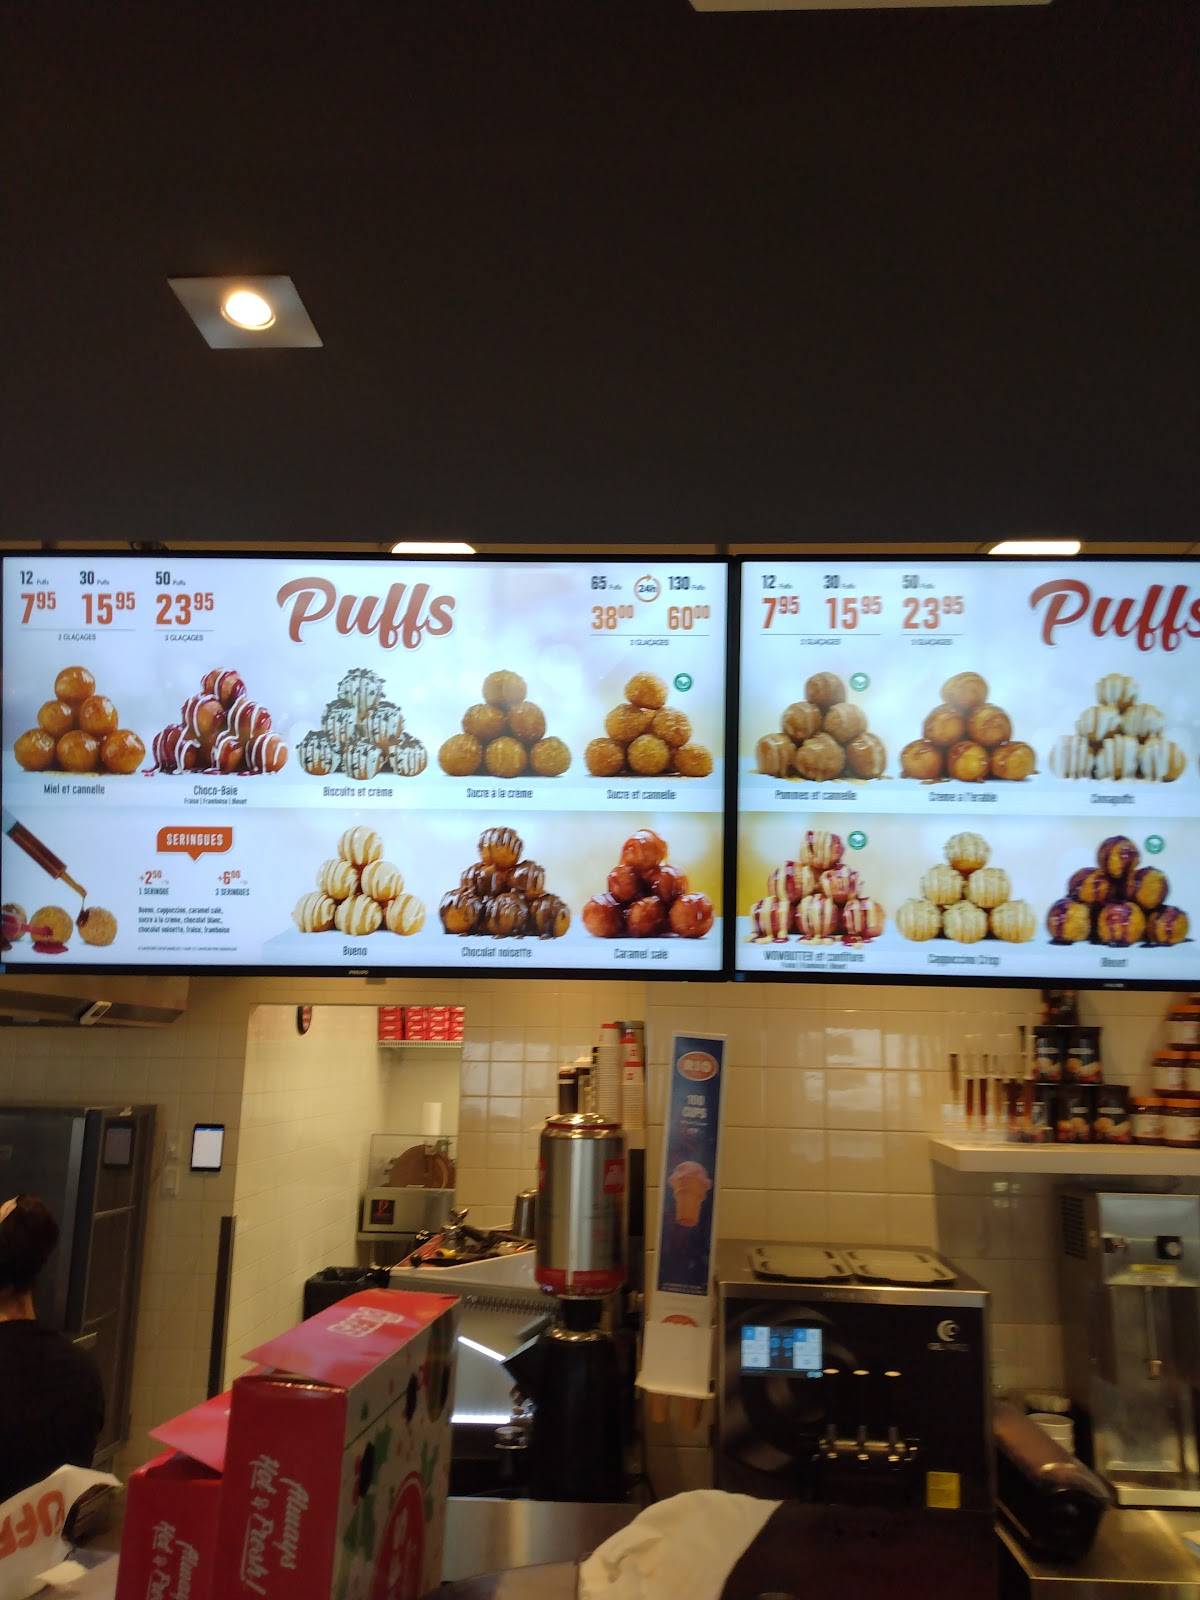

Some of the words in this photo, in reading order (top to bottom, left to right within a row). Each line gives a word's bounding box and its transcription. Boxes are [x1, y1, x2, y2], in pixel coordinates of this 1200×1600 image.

[20, 571, 33, 585] 12
[79, 571, 94, 585] 30
[155, 571, 170, 585] 50
[591, 576, 607, 590] 65
[668, 576, 690, 590] 130
[762, 575, 776, 589] 12
[823, 575, 840, 589] 30
[902, 575, 919, 589] 50
[638, 584, 656, 593] 24h
[277, 577, 456, 649] Puffs
[44, 784, 60, 794] Miel
[62, 785, 70, 794] et
[73, 784, 105, 794] cannelle
[323, 786, 355, 797] Biscuits
[358, 788, 366, 797] et
[467, 788, 489, 798] Sucre
[607, 789, 629, 800] Sucre
[166, 833, 224, 846] SERINGUES
[343, 946, 368, 955] Bueno
[272, 1477, 310, 1570] Always
